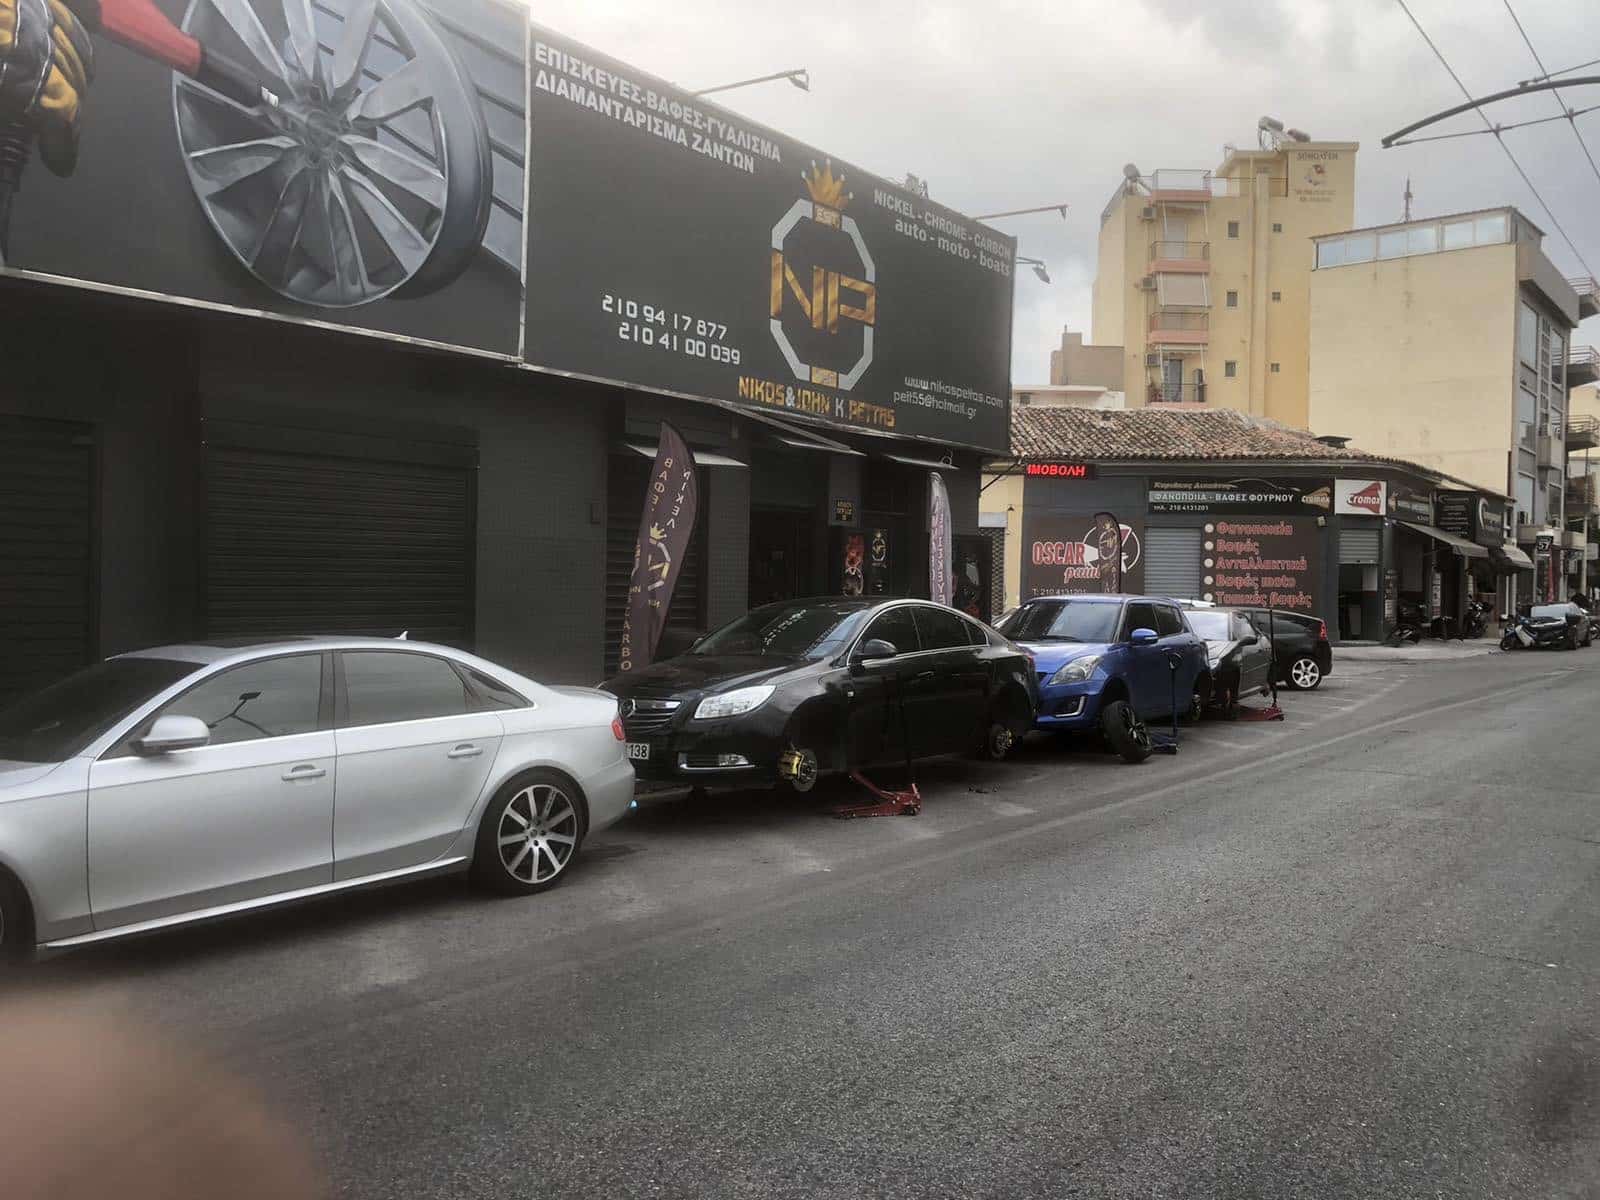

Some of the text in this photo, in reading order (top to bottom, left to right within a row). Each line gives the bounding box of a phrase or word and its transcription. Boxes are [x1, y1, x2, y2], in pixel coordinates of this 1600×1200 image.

[535, 69, 754, 174] ΔΙΑΜΑΝΤΑΡΙΣΜΑ ΖΑΝΤΩΝ
[873, 189, 916, 220] NICKEL
[925, 211, 967, 241] CHROME
[974, 234, 1012, 259] CARBON
[895, 218, 928, 242] auto
[937, 237, 971, 260] moto
[979, 251, 1011, 277] boats
[602, 295, 727, 340] 210 94 17 877
[619, 322, 741, 365] 210 41 00 039
[1215, 493, 1248, 501] ΒΑΦΕΣ
[1249, 494, 1294, 502] ΦΟΥΡΝΟΥ
[1347, 494, 1380, 505] Cromax
[1032, 541, 1085, 566] OSCAR
